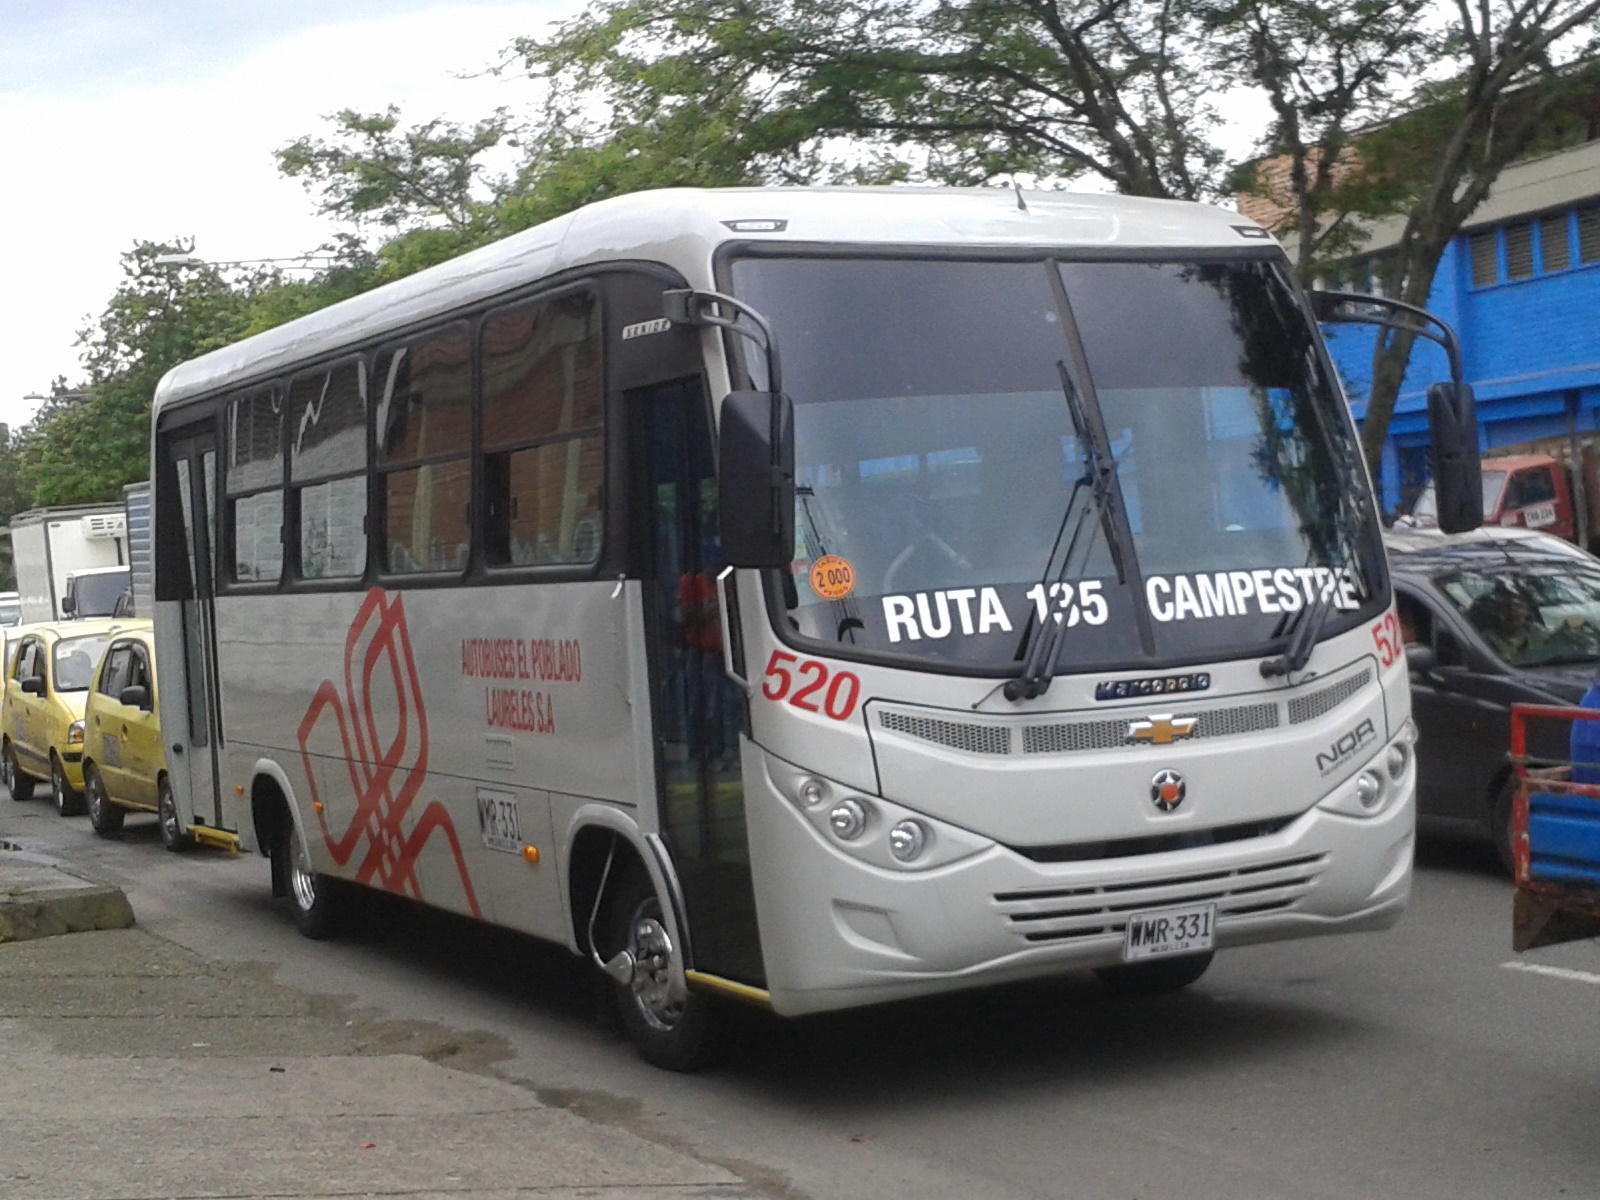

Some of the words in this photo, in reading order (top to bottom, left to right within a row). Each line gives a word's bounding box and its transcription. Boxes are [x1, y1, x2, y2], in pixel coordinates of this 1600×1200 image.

[881, 586, 1014, 643] RUTA
[1026, 580, 1109, 628] 135
[1146, 566, 1361, 622] CAMPESTRE
[461, 638, 516, 678] AUTOBUSES
[516, 638, 530, 679] EL
[531, 638, 582, 682] POBLADO
[761, 649, 861, 721] 520
[485, 686, 536, 732] LAURELES
